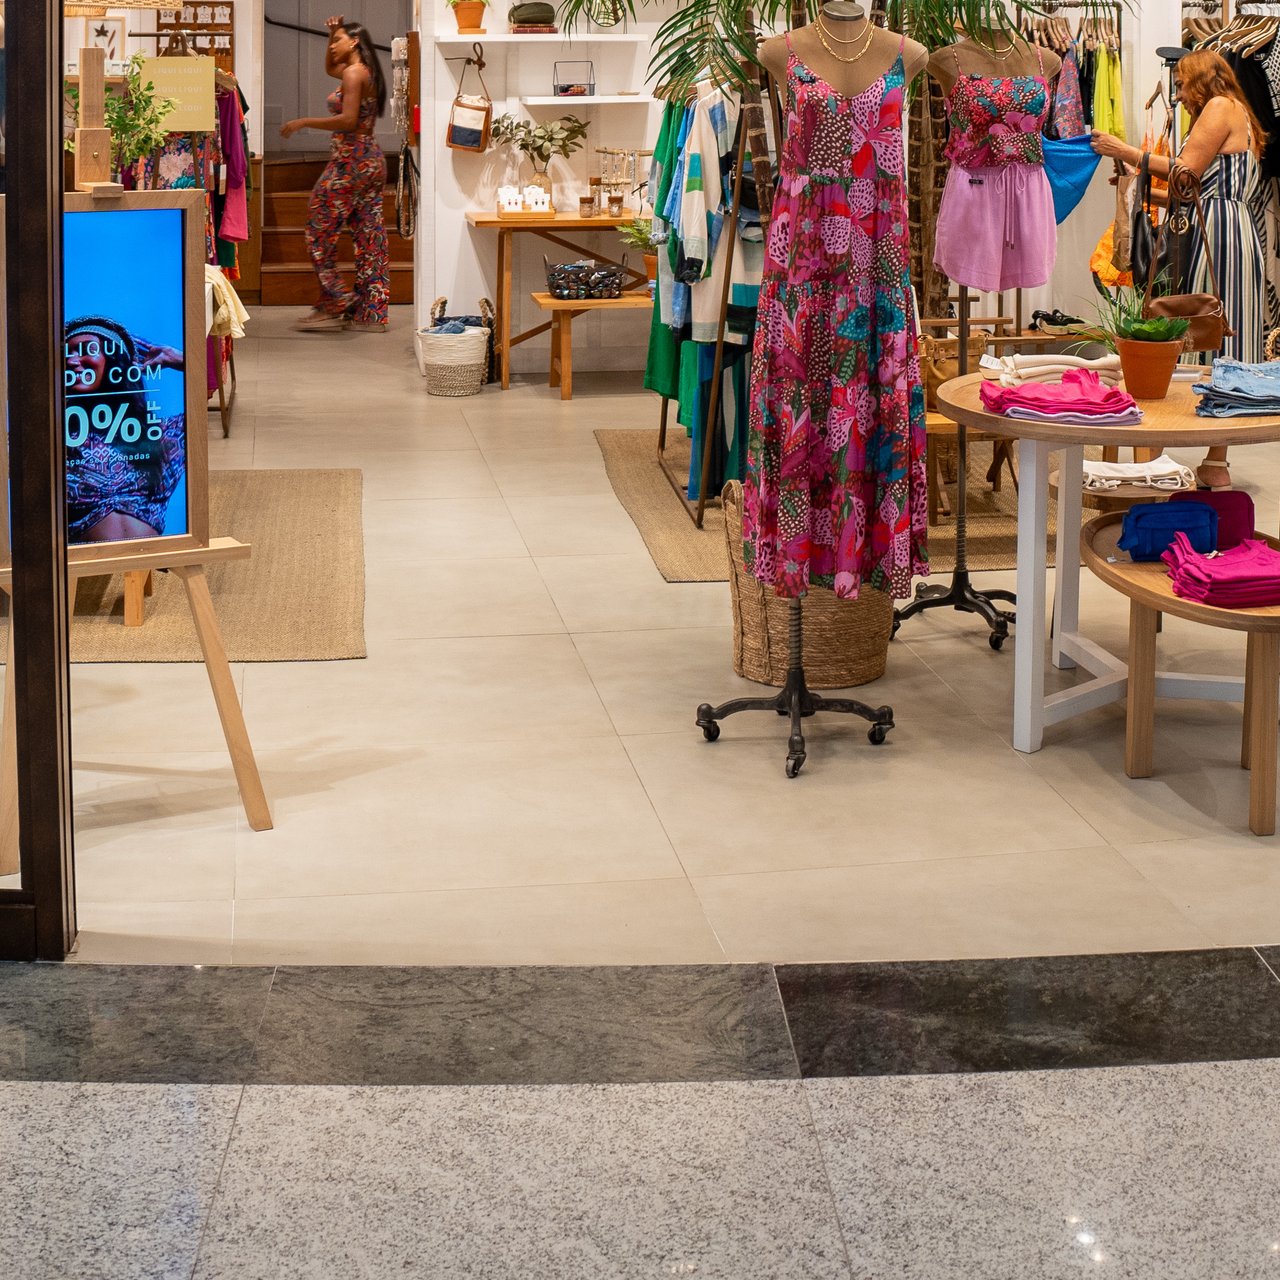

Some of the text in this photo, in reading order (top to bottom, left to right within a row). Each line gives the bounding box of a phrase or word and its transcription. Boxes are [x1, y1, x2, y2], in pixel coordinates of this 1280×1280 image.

[65, 340, 124, 358] LIQUI
[65, 364, 161, 387] DO COM
[65, 402, 142, 448] 0%
[146, 400, 163, 441] OFF
[65, 458, 86, 467] eças
